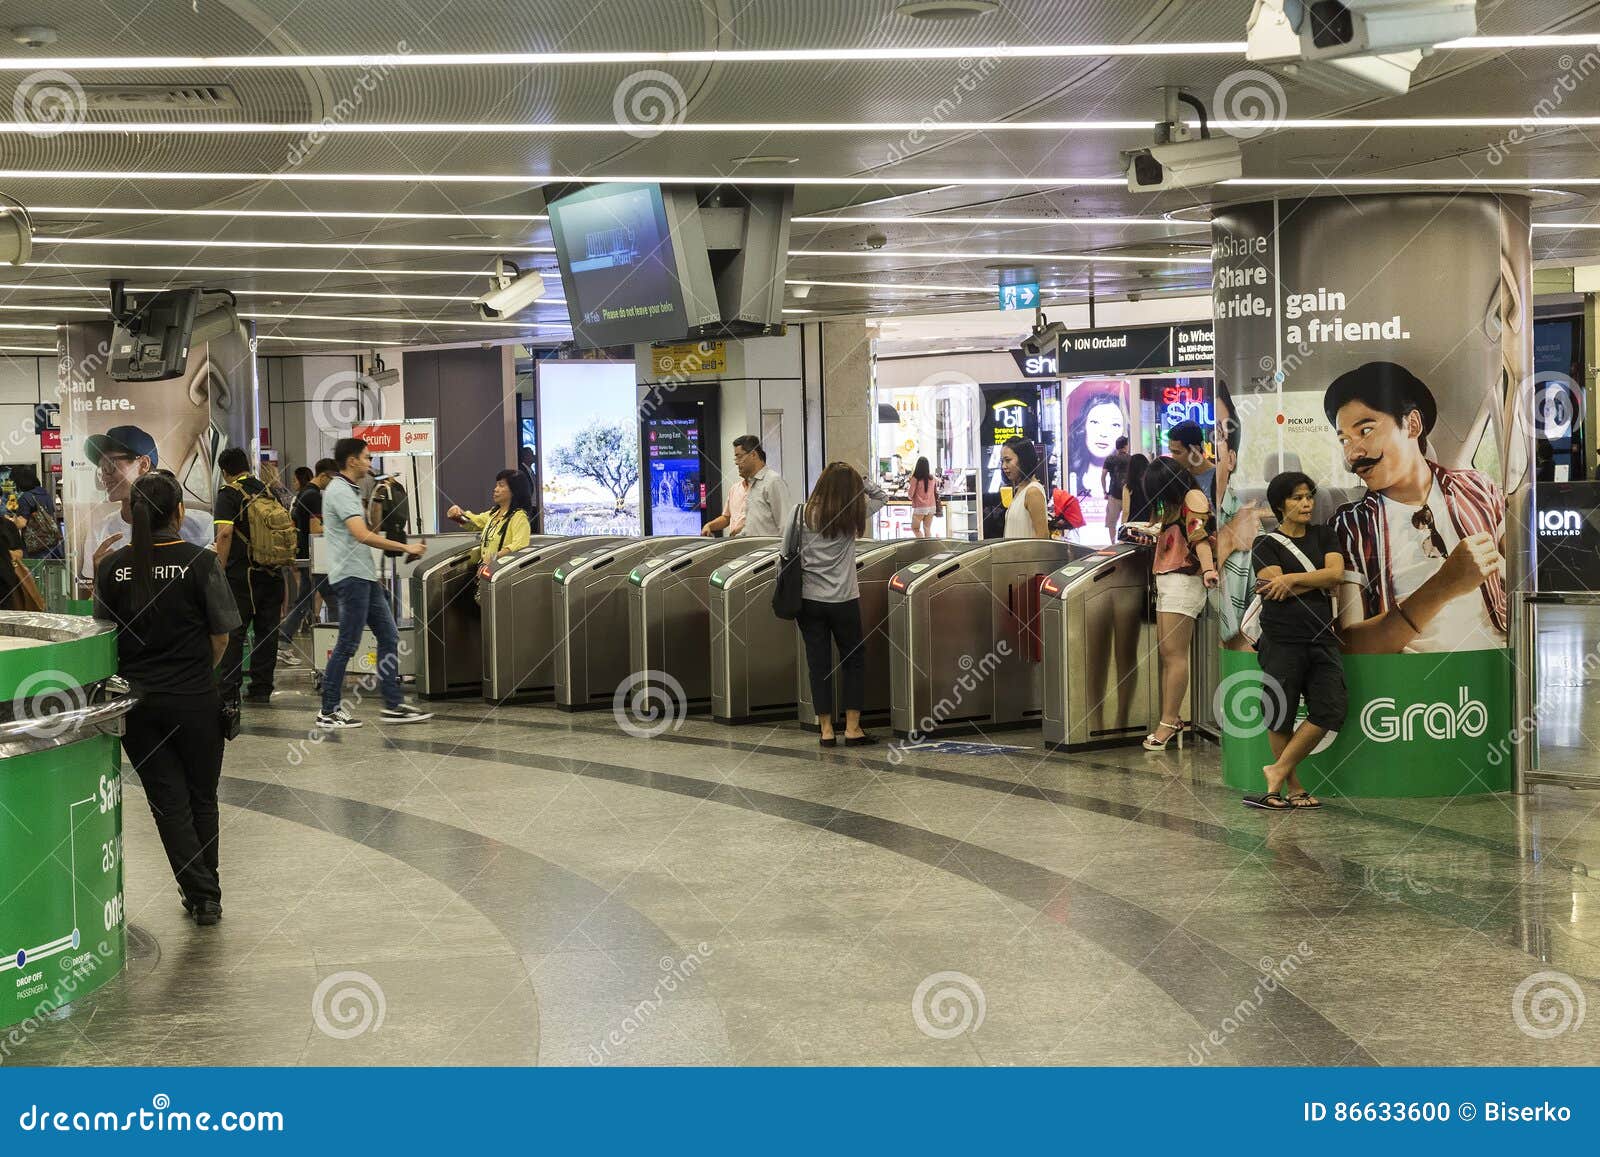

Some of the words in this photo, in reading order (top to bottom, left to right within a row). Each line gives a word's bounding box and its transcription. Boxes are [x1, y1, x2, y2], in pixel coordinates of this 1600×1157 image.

[1228, 293, 1272, 318] ride,
[1286, 287, 1346, 319] gain
[602, 308, 619, 320] Please
[619, 307, 626, 318] do
[633, 305, 648, 317] leave
[648, 304, 660, 317] your
[1178, 331, 1189, 343] to
[1286, 324, 1302, 344] a
[1308, 315, 1411, 343] friend.
[1074, 338, 1091, 350] ION
[1092, 334, 1127, 349] Orchard
[1163, 384, 1204, 405] shu
[73, 397, 93, 411] the
[96, 396, 136, 411] fare.
[1287, 417, 1303, 425] PICK
[362, 431, 391, 447] Security
[115, 565, 190, 582] SERITY
[1360, 686, 1488, 743] Grab
[102, 839, 115, 873] as
[16, 975, 32, 987] DROP
[32, 971, 43, 982] OFF
[16, 984, 45, 1000] PASSENGER
